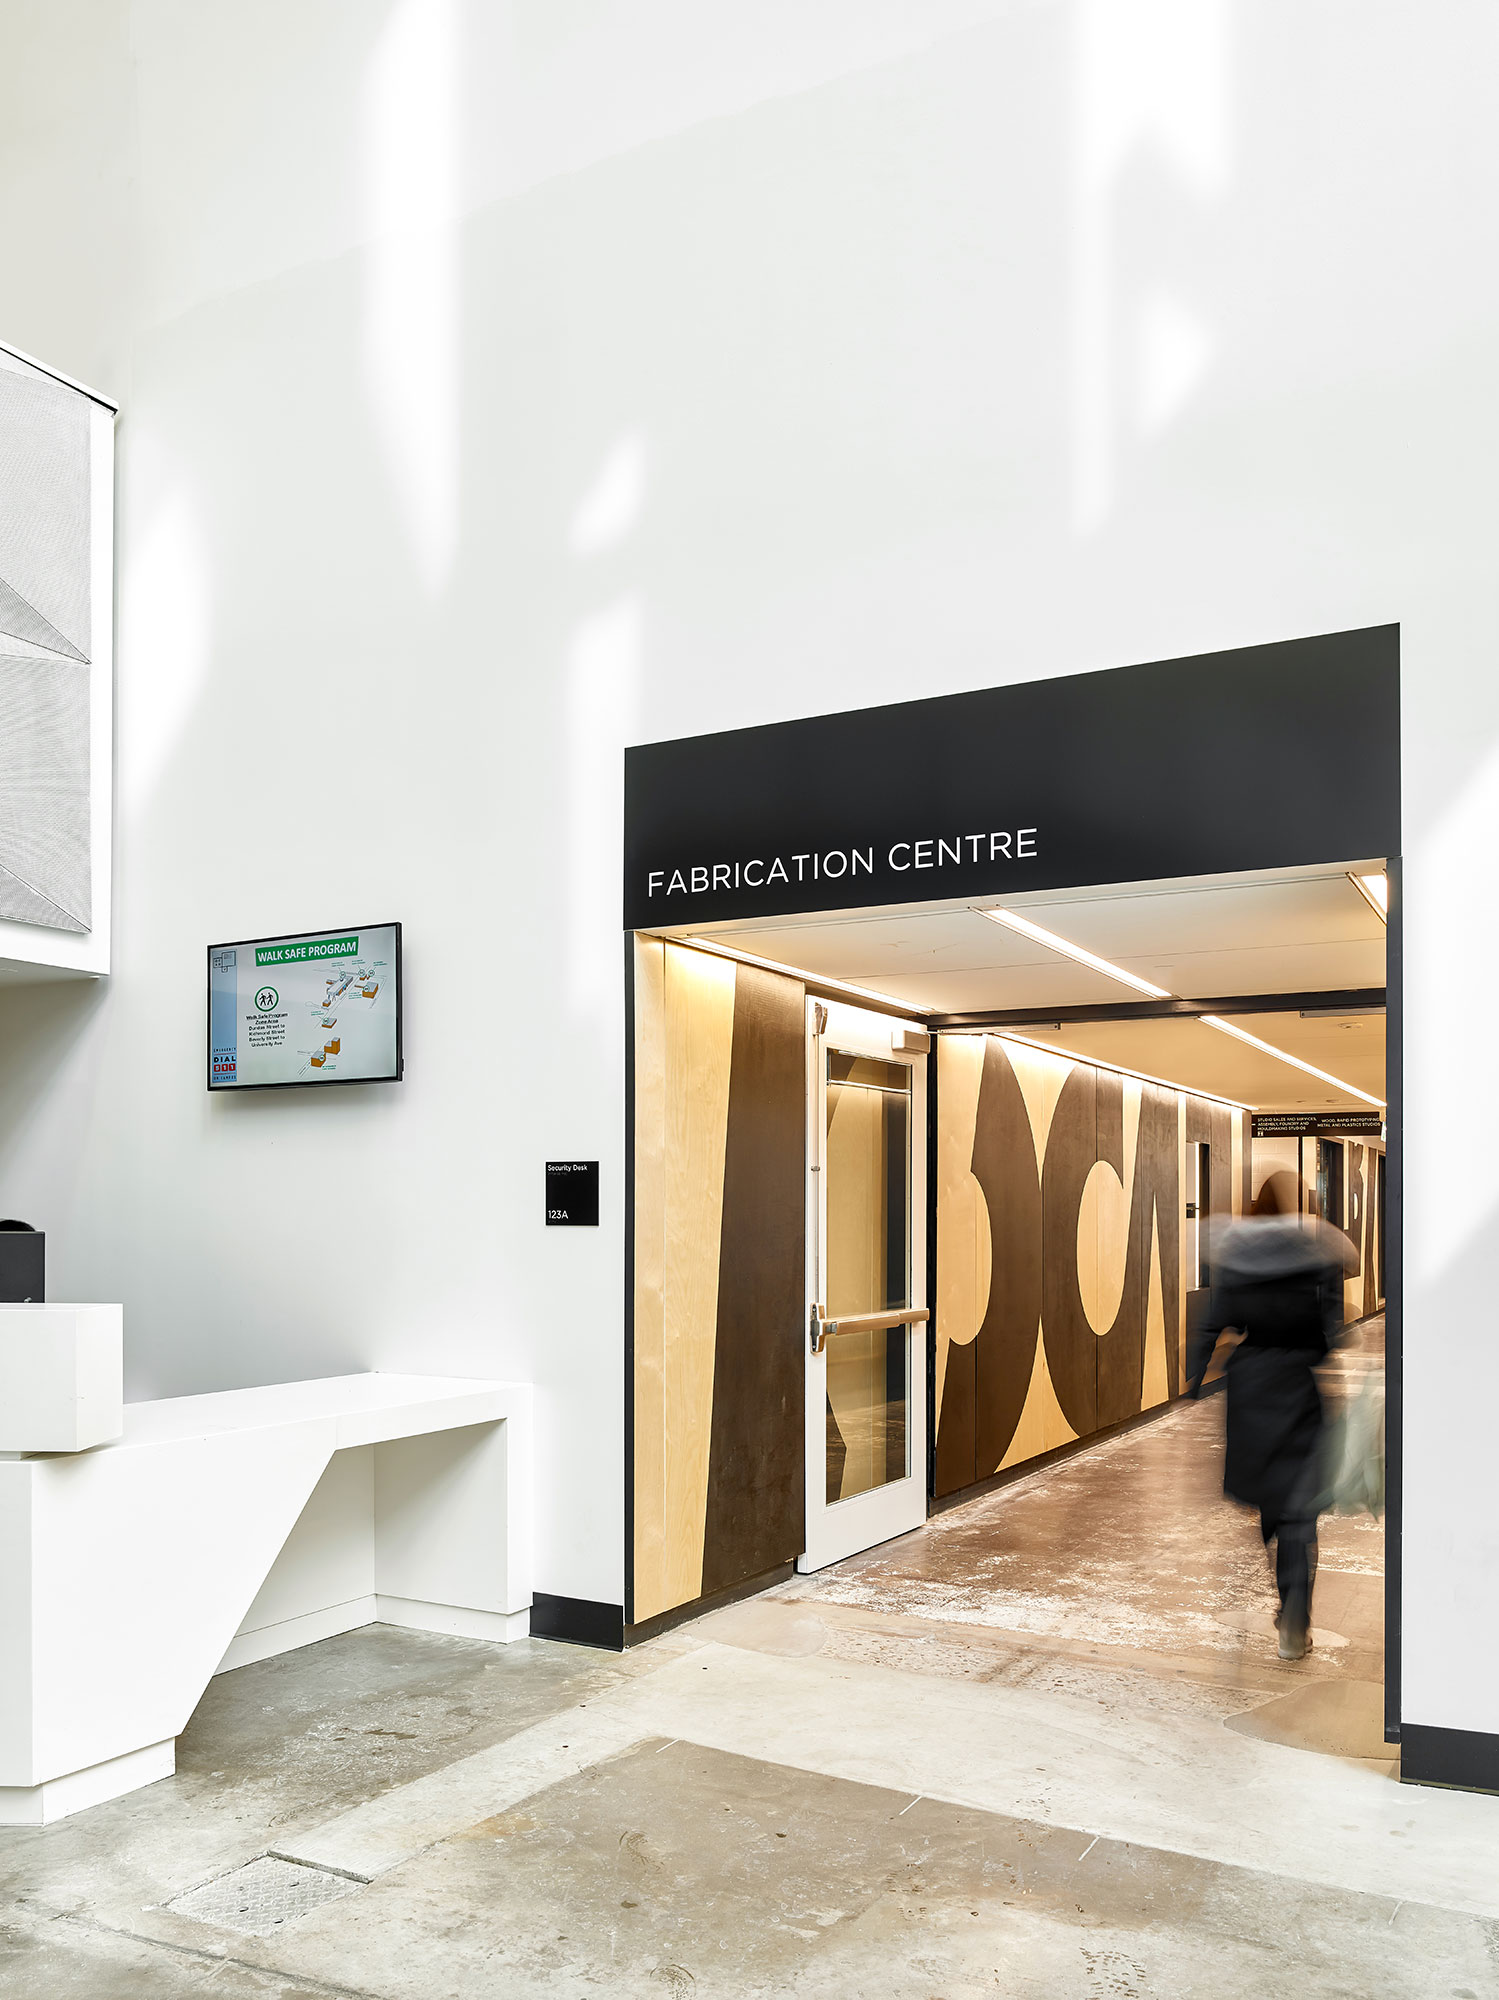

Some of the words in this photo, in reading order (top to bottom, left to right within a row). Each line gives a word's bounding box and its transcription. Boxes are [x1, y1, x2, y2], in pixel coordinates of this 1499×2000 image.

[647, 847, 874, 898] FABRICATION
[888, 827, 1038, 871] CENTRE
[257, 950, 284, 963] WALK
[284, 948, 306, 960] SAFE
[308, 942, 356, 957] PROGRAM
[547, 1164, 571, 1172] Security
[547, 1210, 569, 1219] 123A
